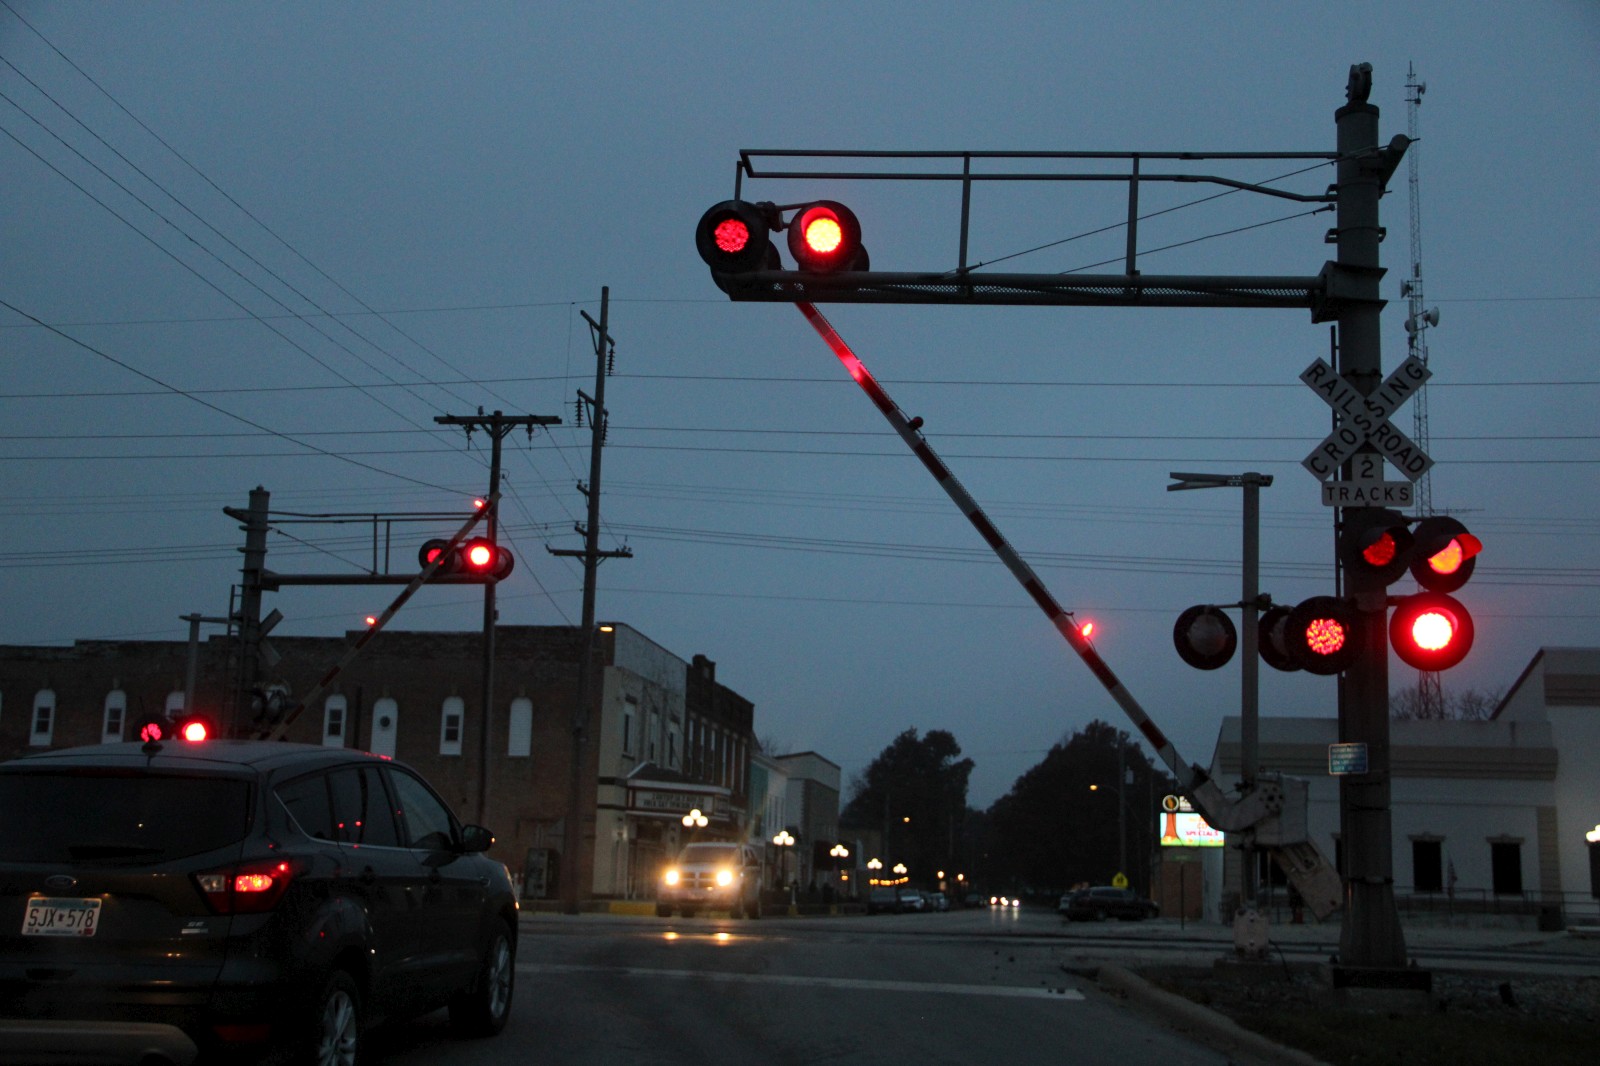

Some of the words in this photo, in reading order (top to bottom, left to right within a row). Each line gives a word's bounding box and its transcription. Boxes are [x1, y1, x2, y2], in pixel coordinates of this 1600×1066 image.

[1310, 363, 1424, 475] CROSSING
[1360, 459, 1374, 478] 2
[1326, 486, 1409, 501] TRACKS
